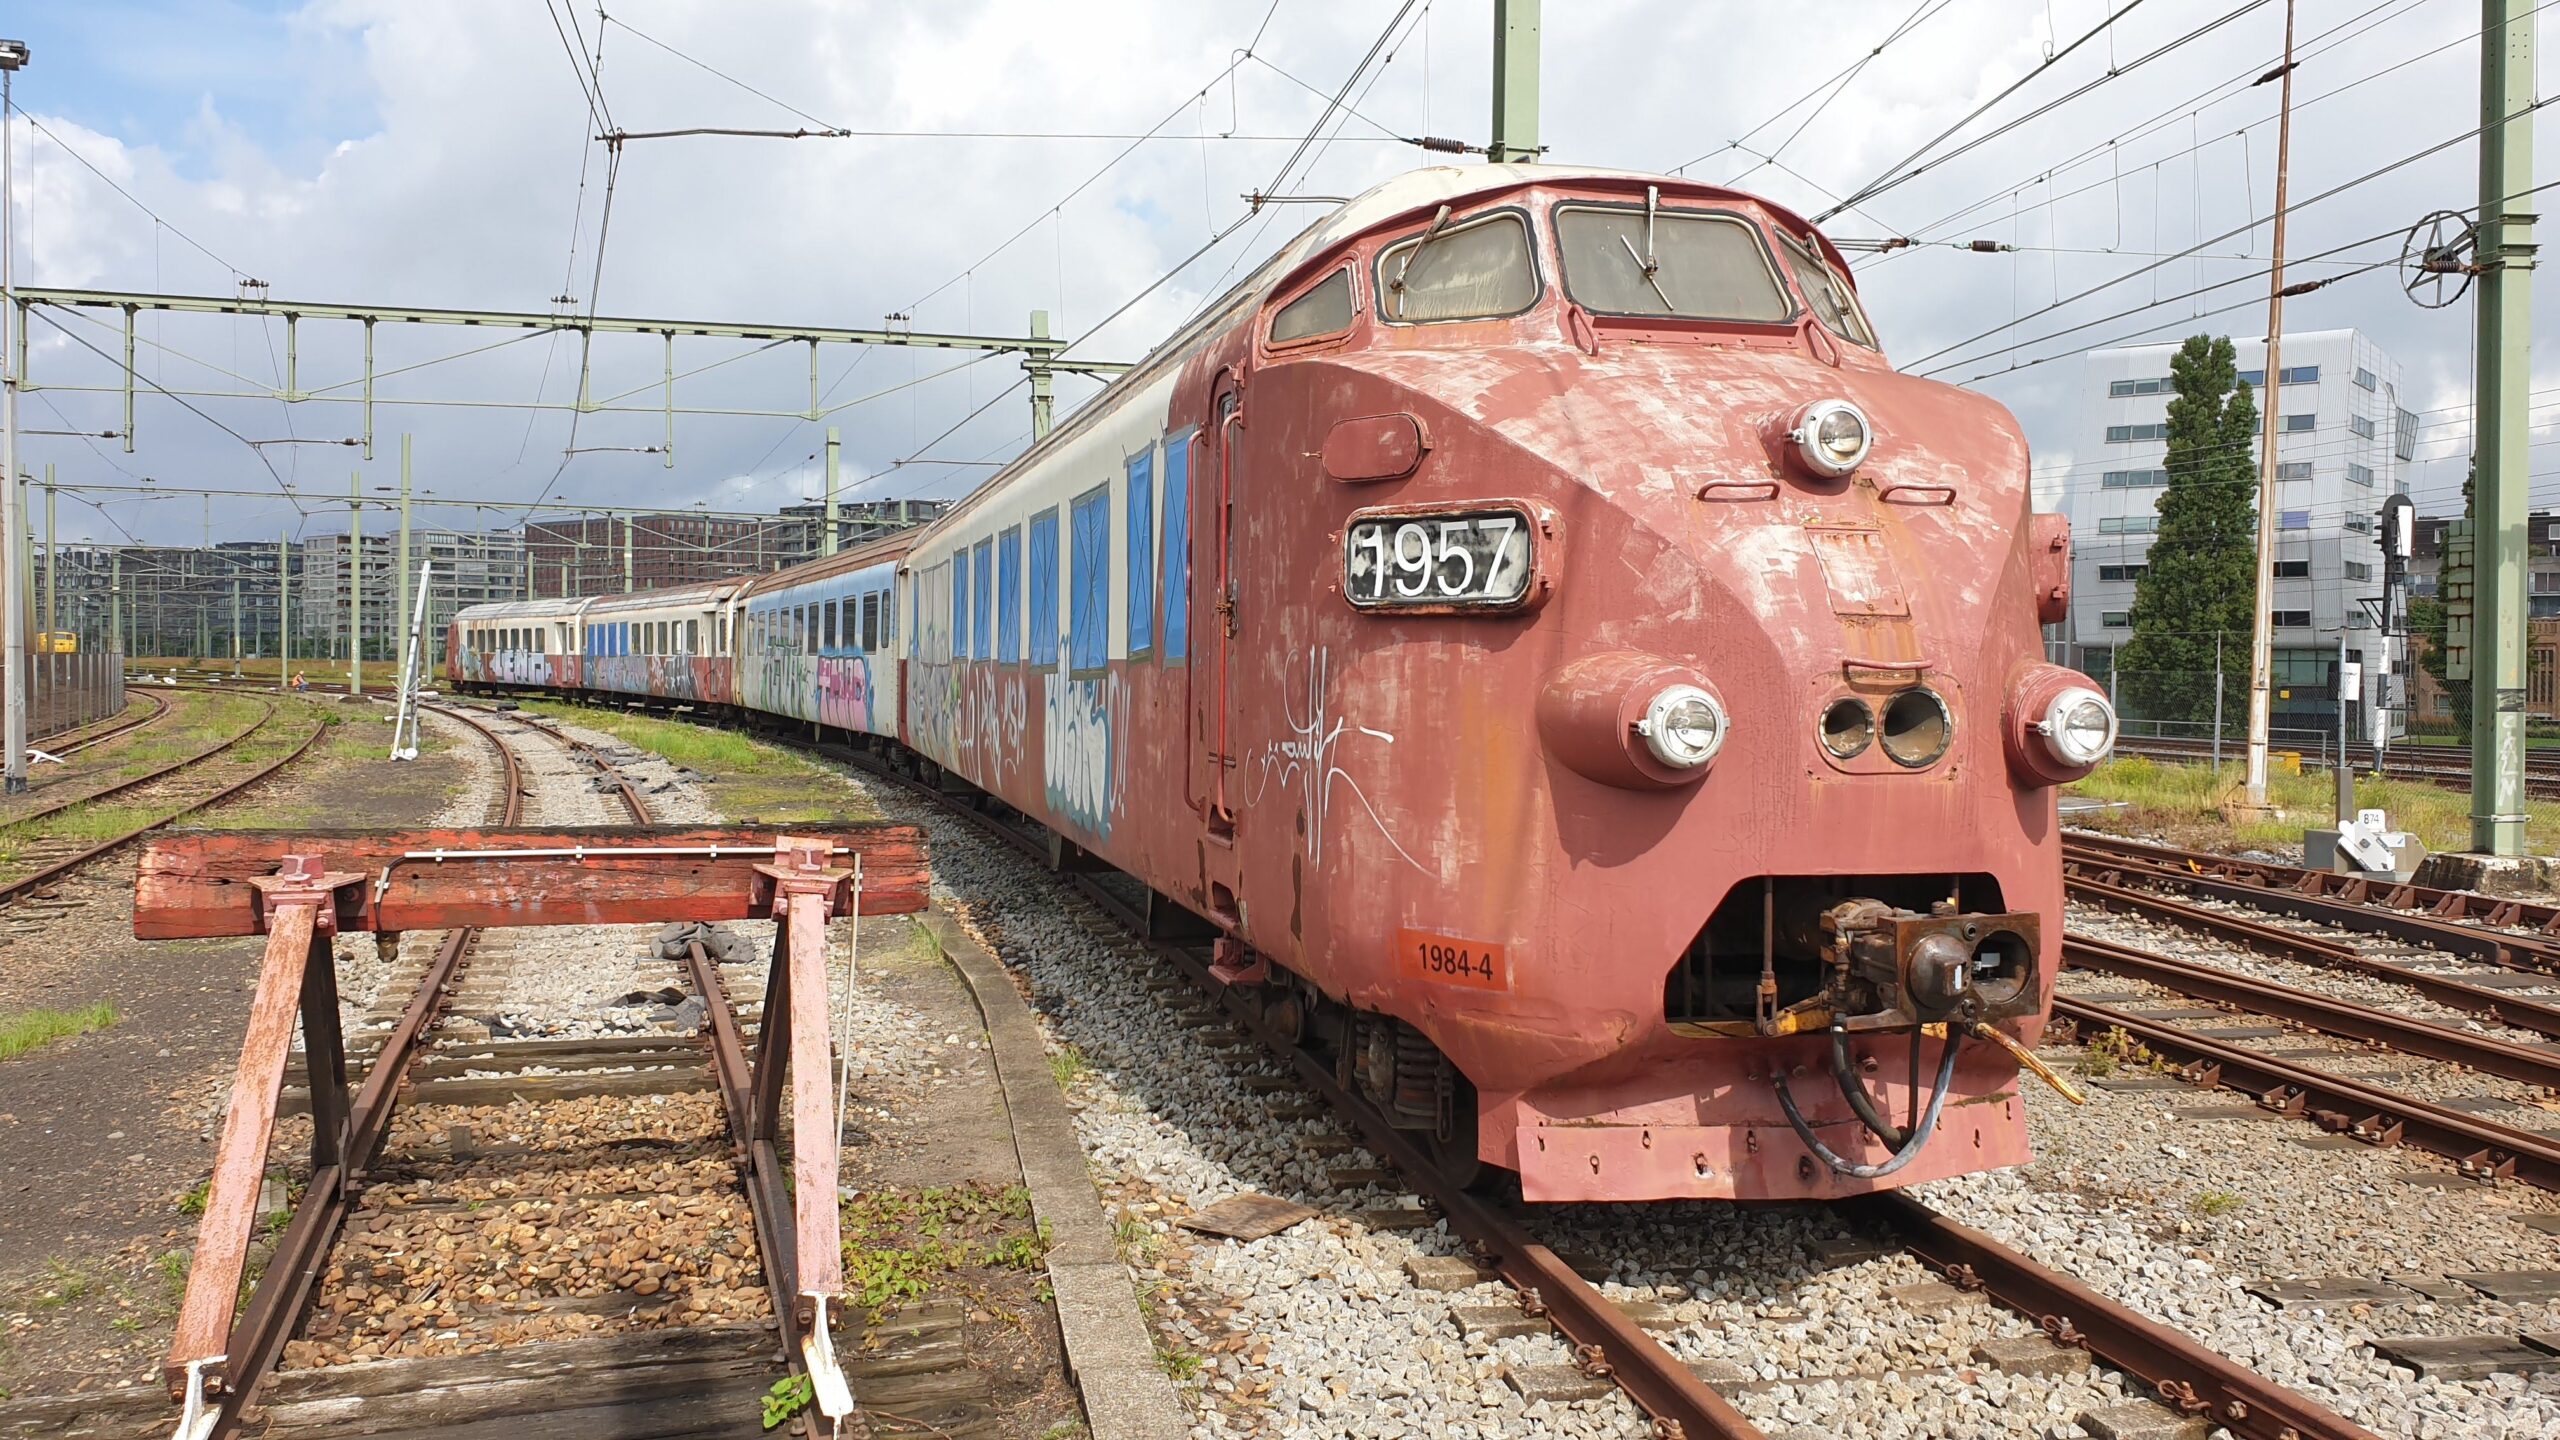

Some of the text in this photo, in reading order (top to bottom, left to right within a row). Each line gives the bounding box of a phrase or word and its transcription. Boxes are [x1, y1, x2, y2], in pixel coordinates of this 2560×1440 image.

[1361, 517, 1517, 598] 1957
[2363, 813, 2380, 825] 874
[1418, 943, 1494, 981] 1984-4
